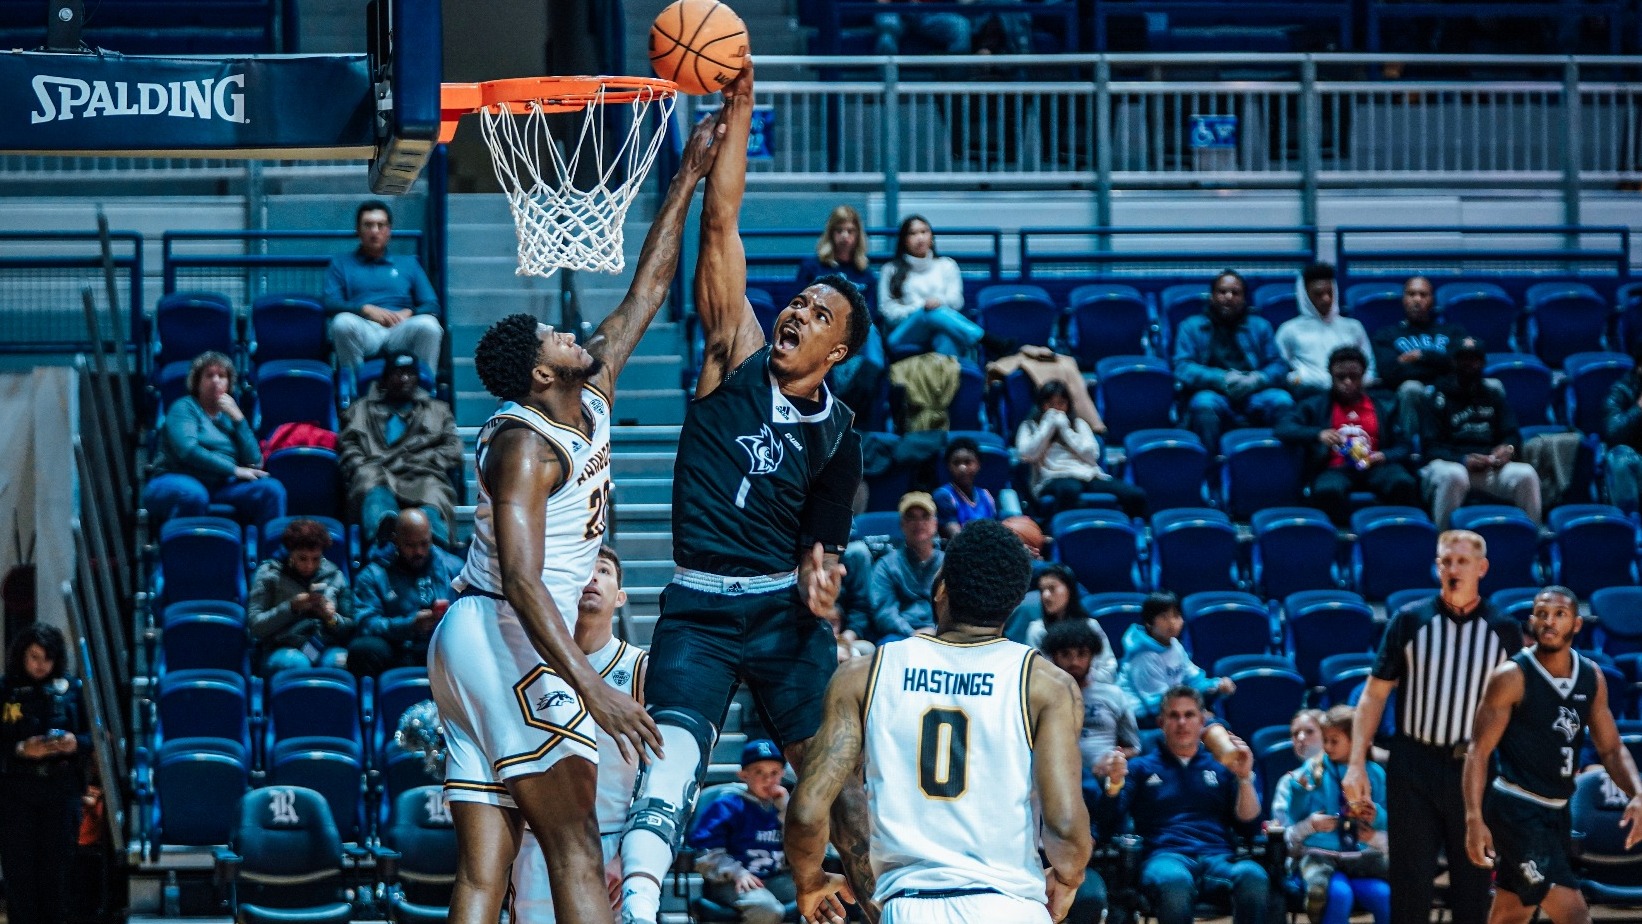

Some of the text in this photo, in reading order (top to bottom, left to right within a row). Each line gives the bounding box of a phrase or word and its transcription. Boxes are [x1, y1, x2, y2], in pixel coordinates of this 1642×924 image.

[31, 74, 245, 124] SPALDING
[735, 476, 751, 509] 1
[903, 668, 994, 696] HASTINGS
[916, 704, 971, 802] 0
[1560, 746, 1574, 778] 3
